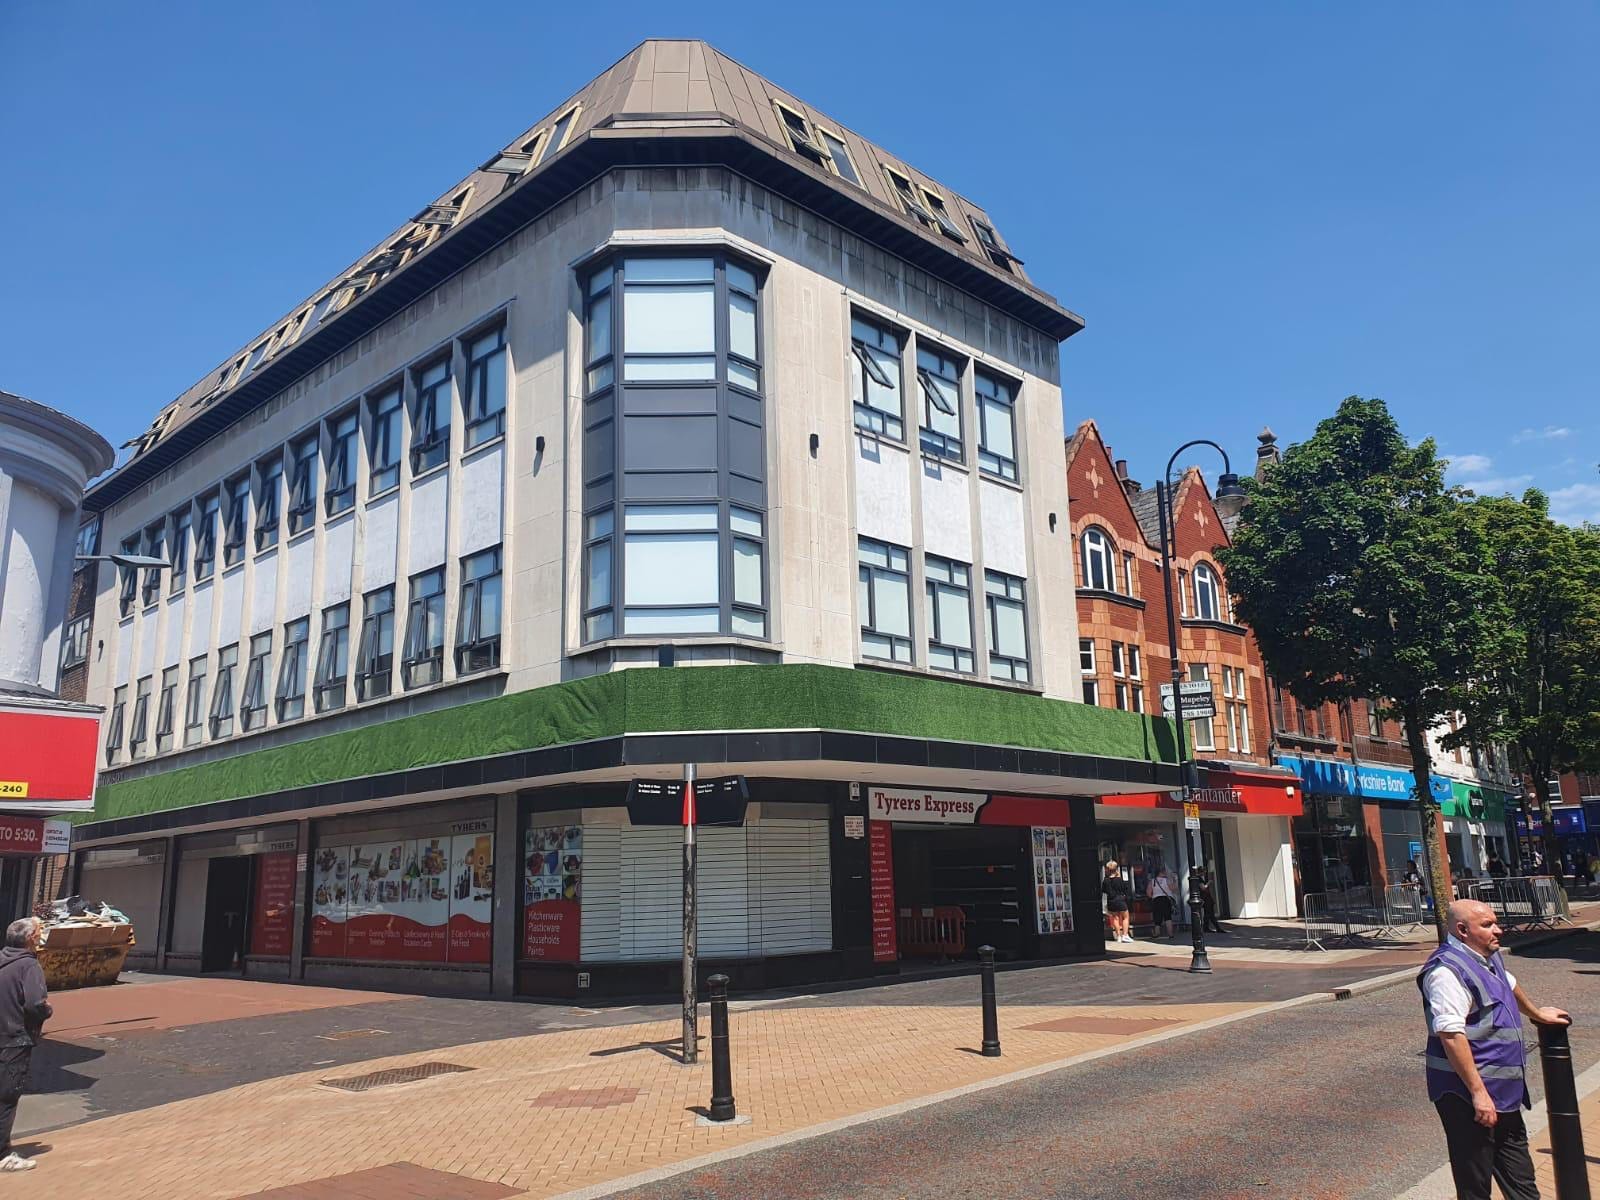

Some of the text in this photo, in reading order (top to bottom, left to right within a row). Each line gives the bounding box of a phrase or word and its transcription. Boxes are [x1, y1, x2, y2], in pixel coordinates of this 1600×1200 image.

[1386, 775, 1406, 793] Bank
[874, 792, 975, 817] Tyrers Express
